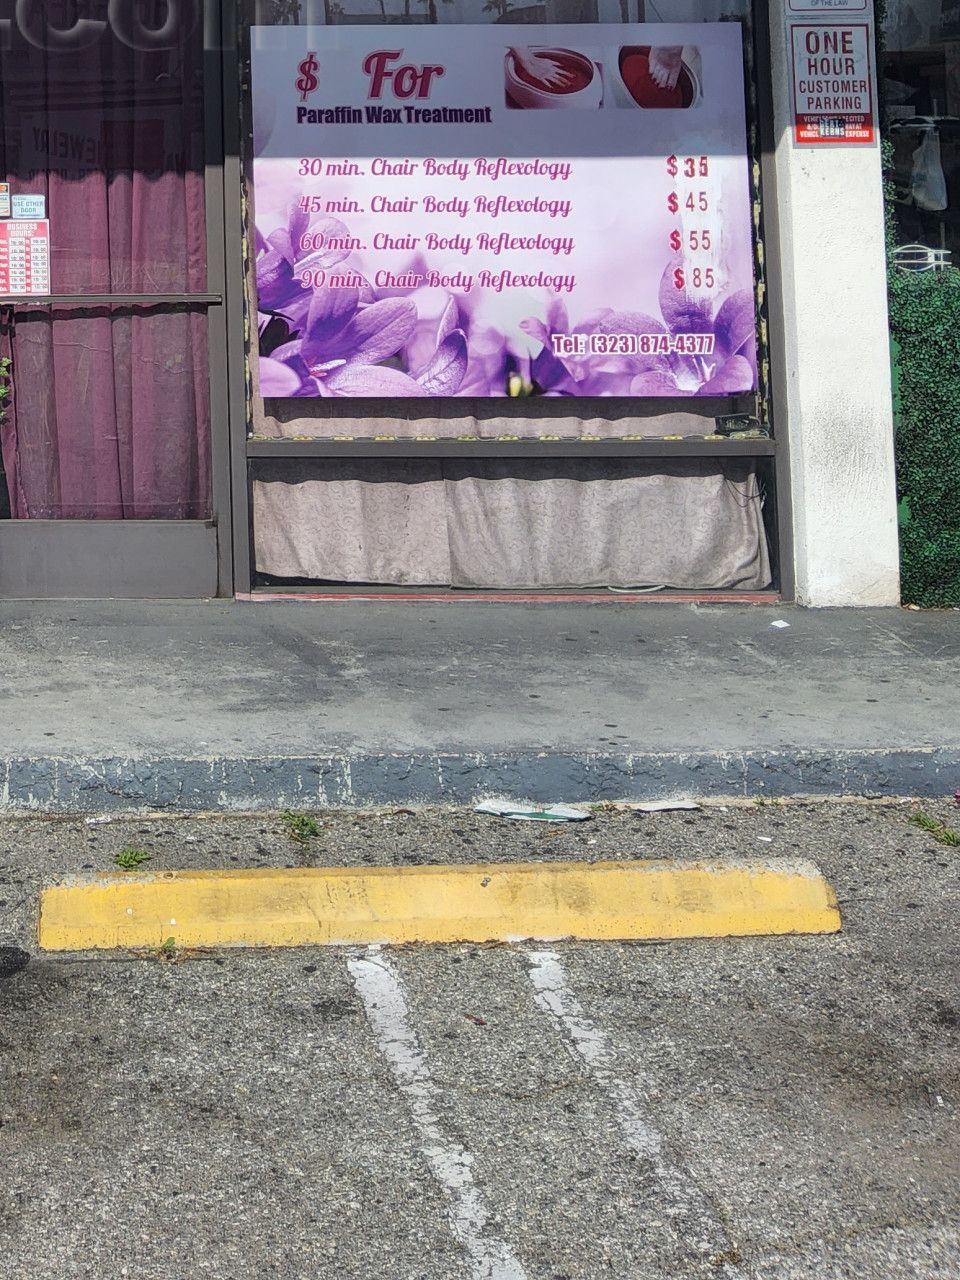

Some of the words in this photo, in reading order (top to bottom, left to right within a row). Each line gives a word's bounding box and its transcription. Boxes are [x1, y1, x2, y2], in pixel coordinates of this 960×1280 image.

[806, 30, 853, 55] ONE
[296, 52, 319, 102] $
[363, 49, 446, 100] For
[807, 58, 855, 76] HOUR
[799, 80, 867, 94] CUSTOMER
[807, 96, 861, 110] PARKING
[297, 106, 363, 124] Paraffin
[365, 106, 402, 124] Wax
[405, 106, 492, 124] Treatment
[298, 159, 323, 177] 30
[326, 159, 365, 177] min.
[371, 158, 418, 177] Chair
[423, 158, 470, 180] Body
[474, 158, 573, 180] Reflexology
[300, 195, 322, 215] 45
[326, 196, 365, 214] min.
[370, 195, 418, 214] Chair
[423, 195, 470, 217] Body
[474, 195, 573, 218] Reflexology
[300, 232, 325, 251] 60
[327, 232, 368, 251] min.
[373, 232, 421, 251] Chair
[425, 232, 472, 255] Body
[476, 232, 575, 255] Reflexology
[300, 270, 326, 290] 90
[329, 270, 370, 289] min.
[374, 269, 423, 290] Chair
[427, 270, 474, 292] Body
[479, 270, 577, 293] Reflexology
[553, 334, 585, 355] Tel:
[591, 333, 636, 355] (323)
[640, 333, 714, 355] 874-4377
